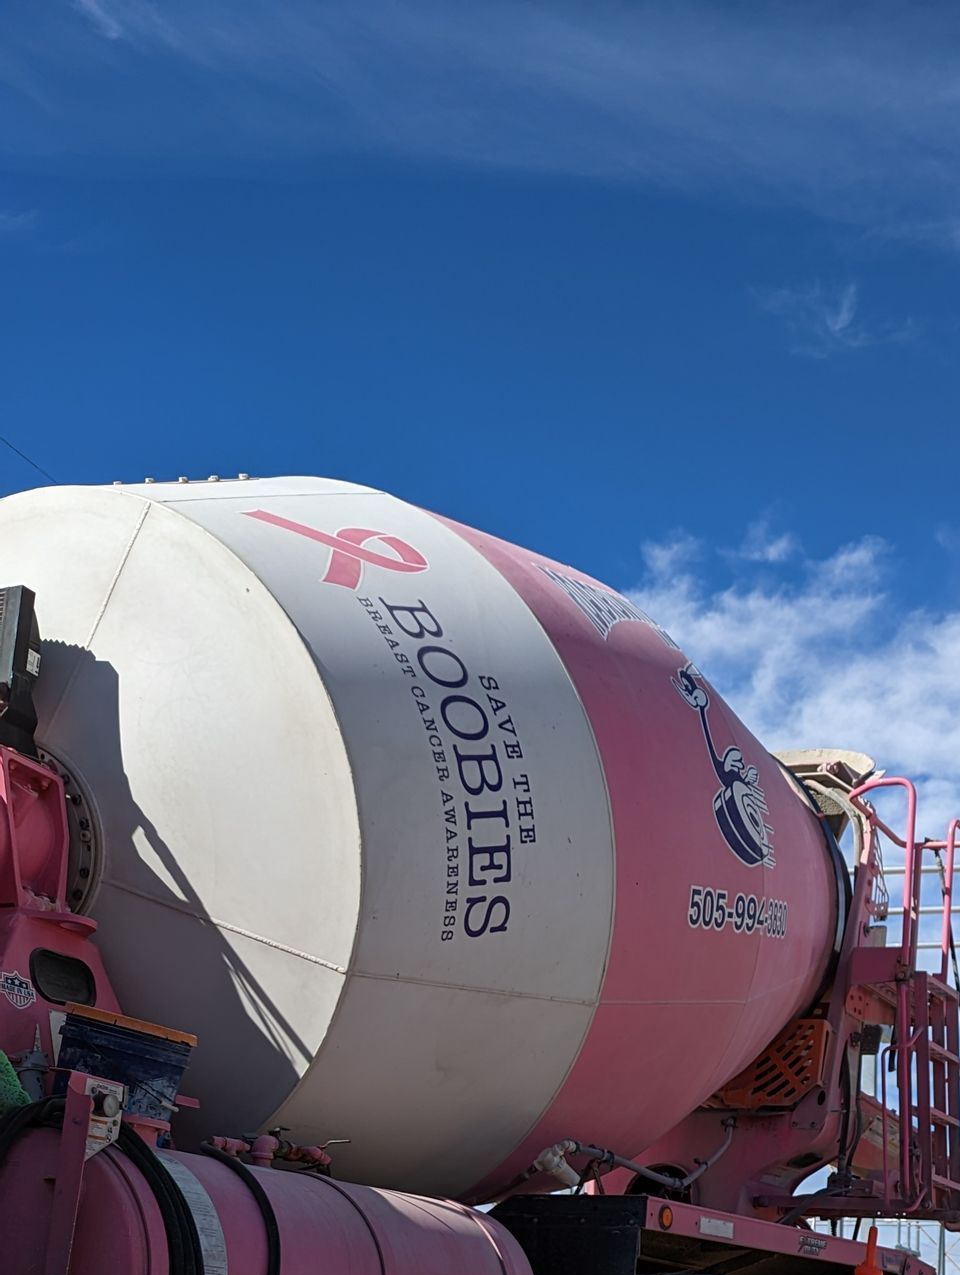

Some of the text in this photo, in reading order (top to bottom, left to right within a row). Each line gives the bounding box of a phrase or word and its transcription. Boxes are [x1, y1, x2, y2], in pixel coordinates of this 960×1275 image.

[356, 596, 459, 942] BREAST CANCER AWARENESS
[378, 595, 512, 938] BOOBIES
[478, 675, 536, 844] SAVE THE
